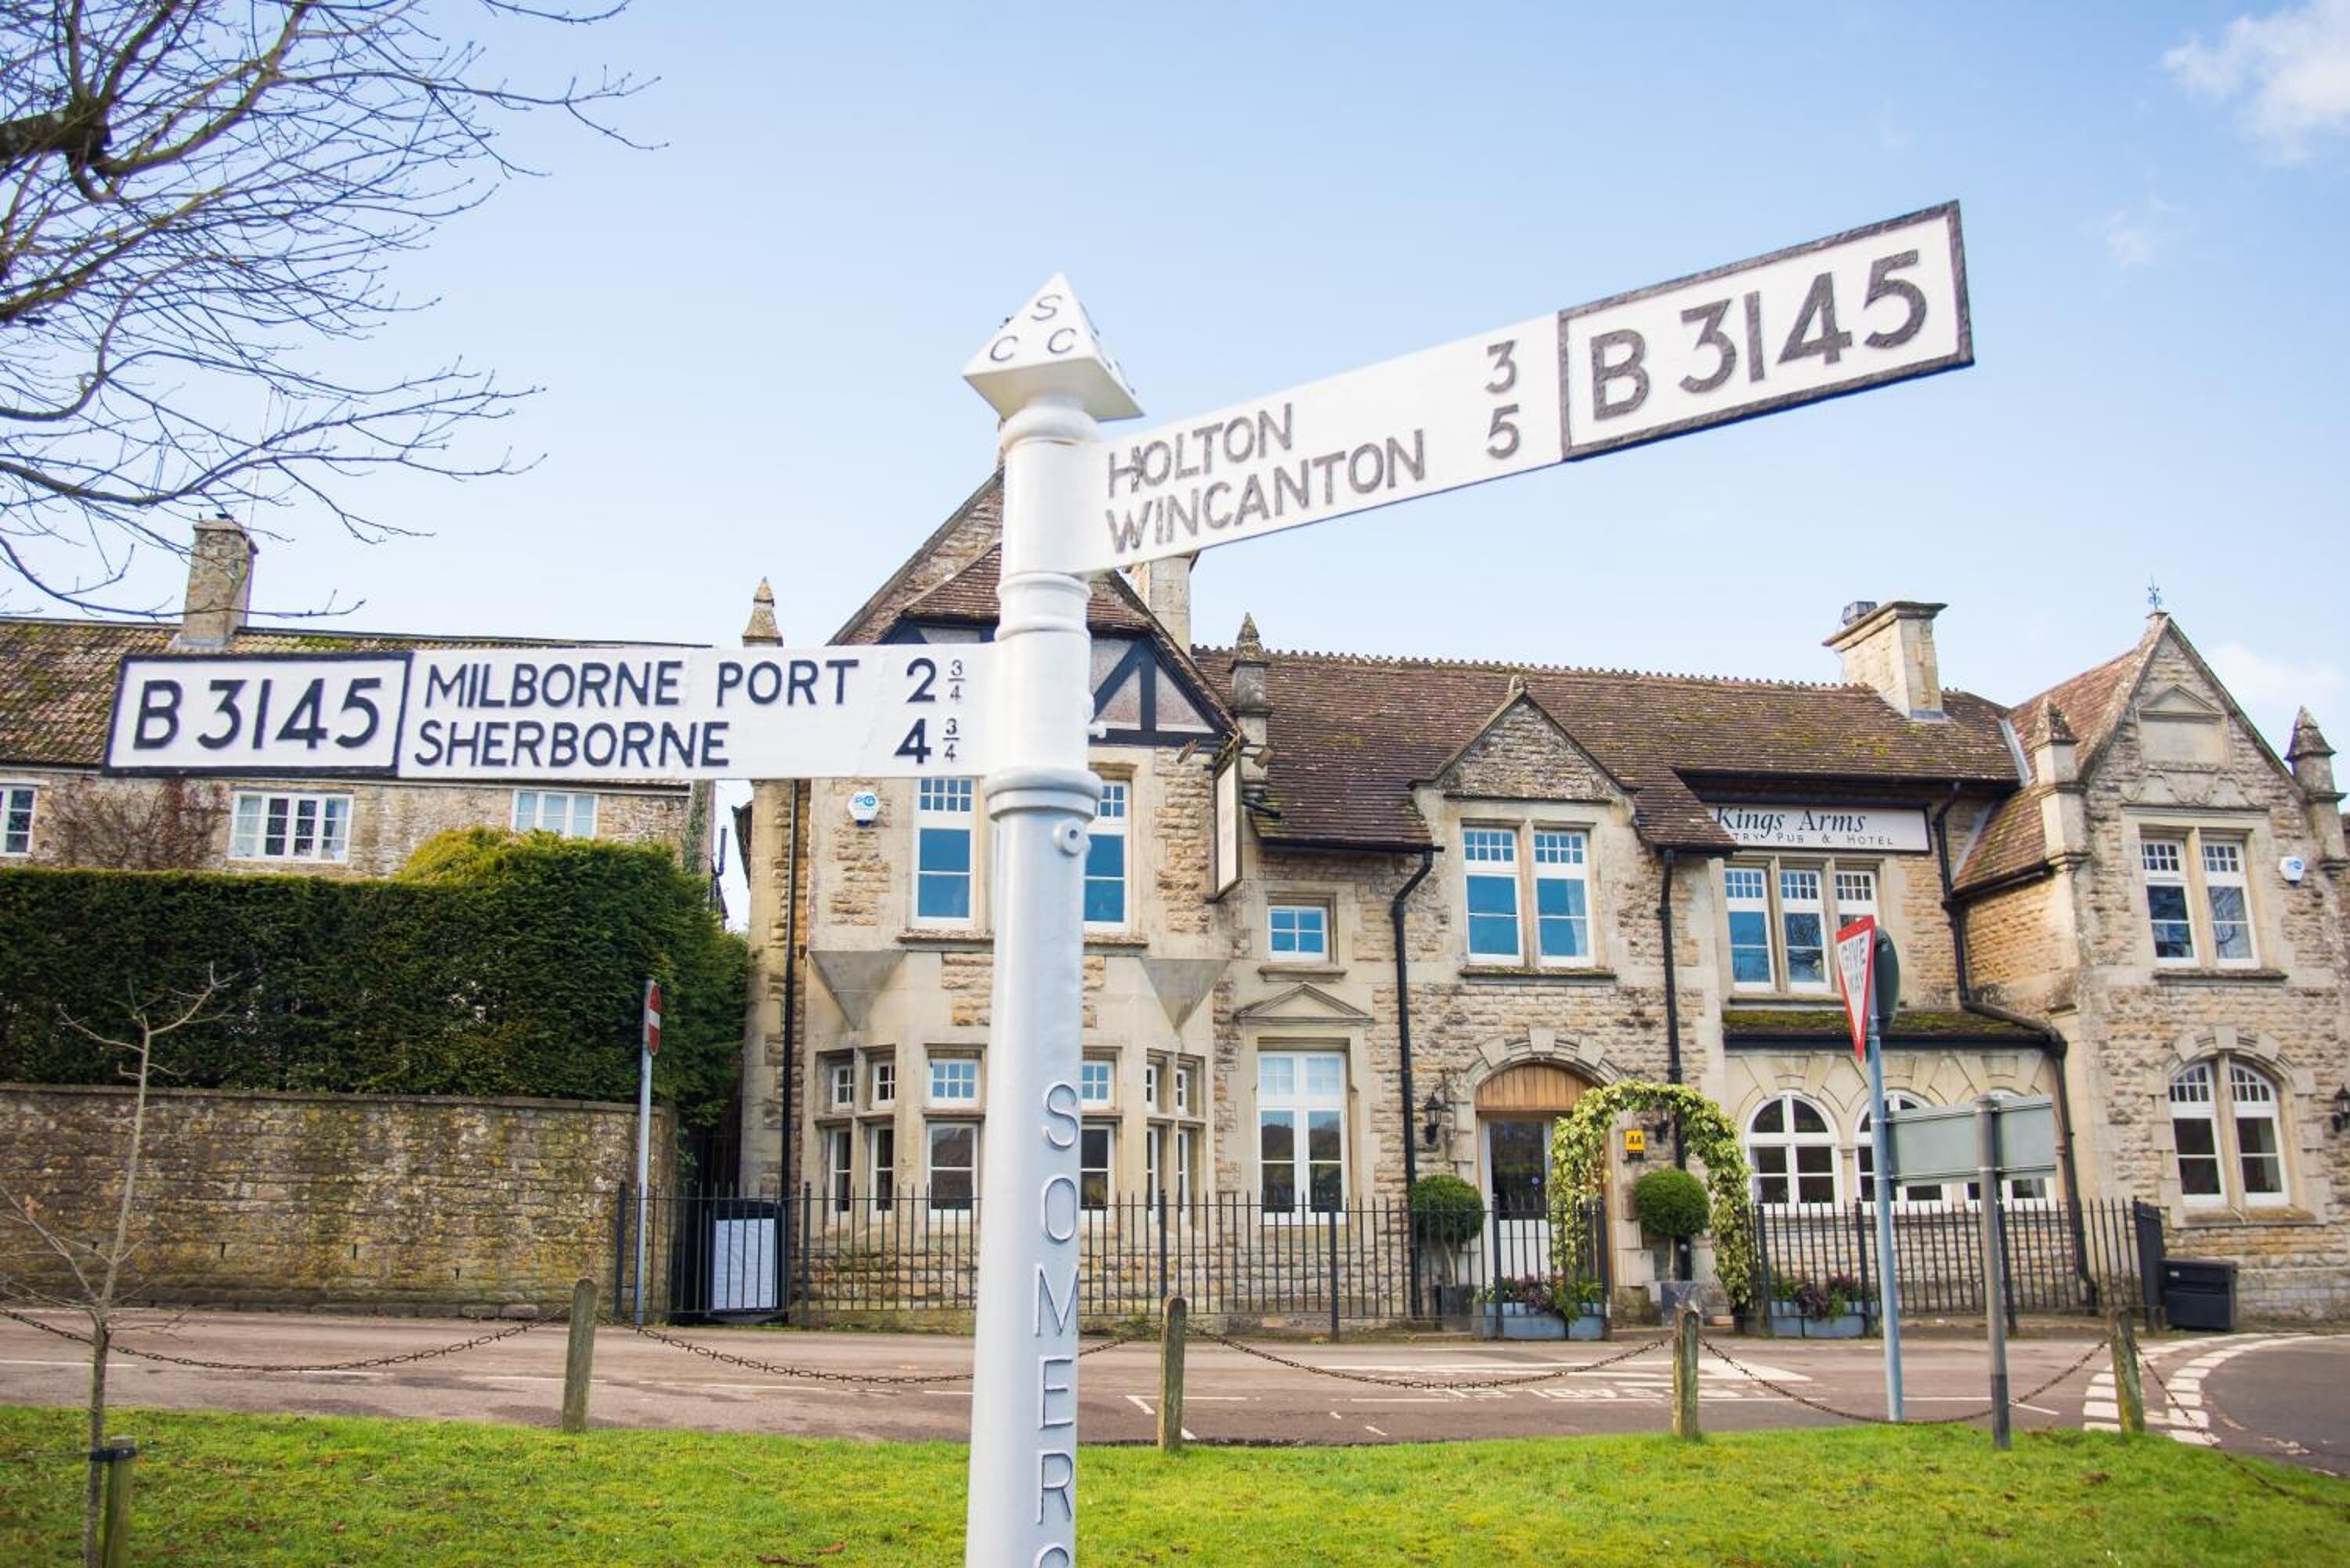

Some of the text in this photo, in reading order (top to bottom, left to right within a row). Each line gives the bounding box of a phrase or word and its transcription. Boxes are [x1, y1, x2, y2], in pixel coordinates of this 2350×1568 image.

[1590, 249, 1928, 422] B 3145
[1108, 340, 1517, 499] HOLTON 3
[1105, 403, 1520, 553] WINCANTON 5
[133, 677, 381, 750] B 3145
[425, 661, 683, 709] MILBORNE
[717, 659, 859, 708] PORT
[415, 719, 730, 768] SHERBORNE
[1717, 807, 1867, 839] Kings Arms
